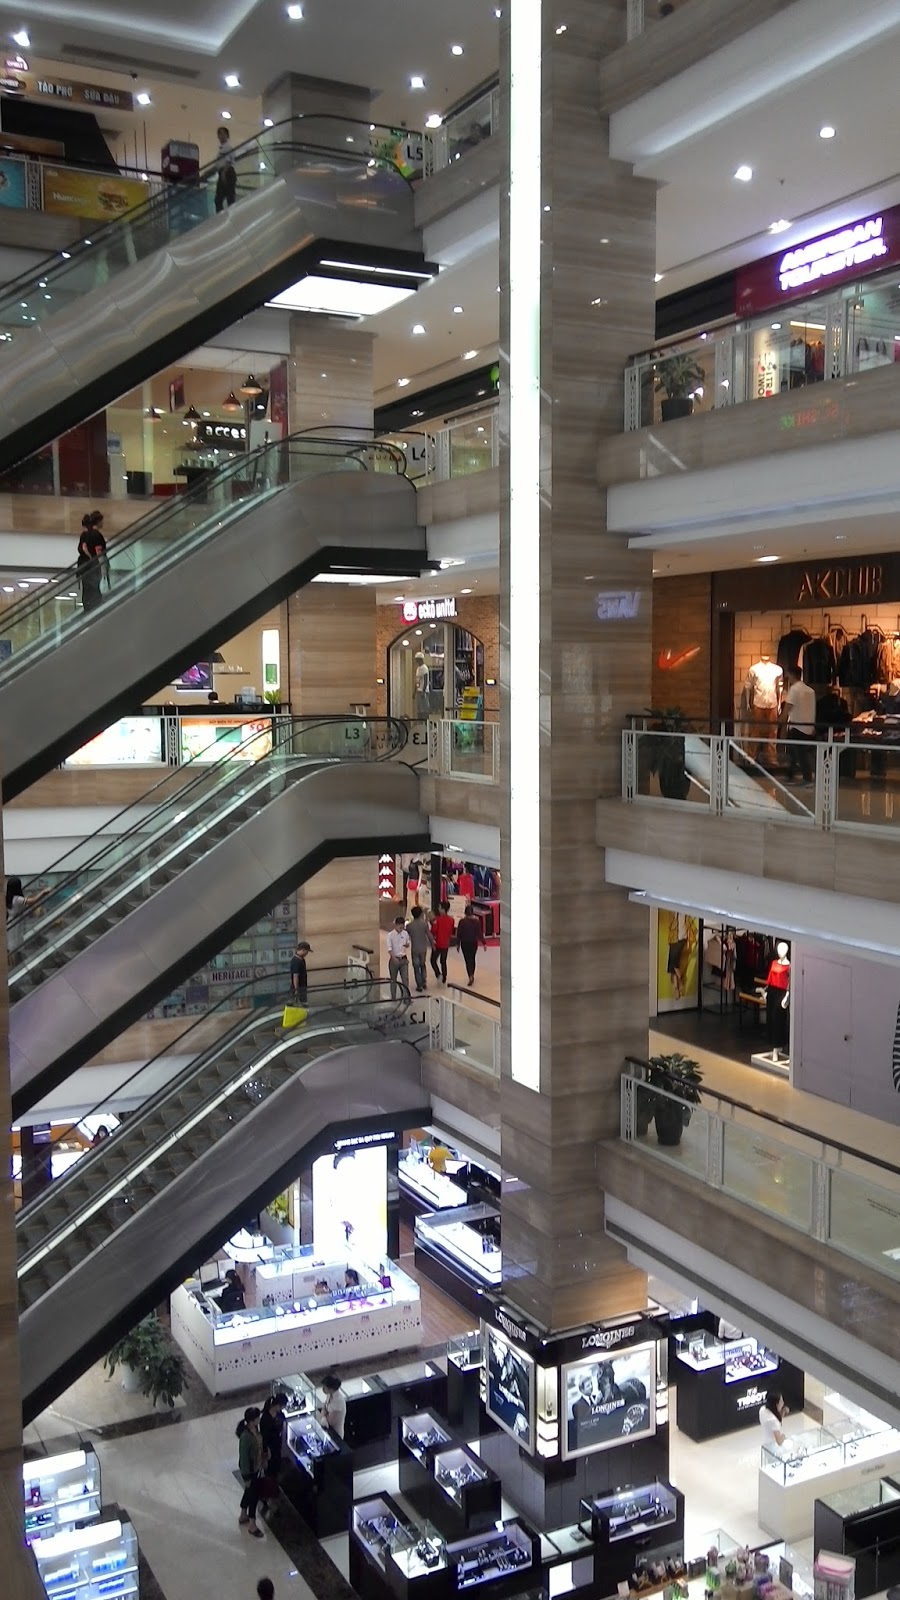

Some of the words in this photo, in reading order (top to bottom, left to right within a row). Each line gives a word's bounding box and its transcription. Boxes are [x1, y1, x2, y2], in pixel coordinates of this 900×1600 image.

[345, 728, 360, 740] L3
[212, 969, 251, 981] HERITAGE
[581, 1325, 635, 1350] LONGINES
